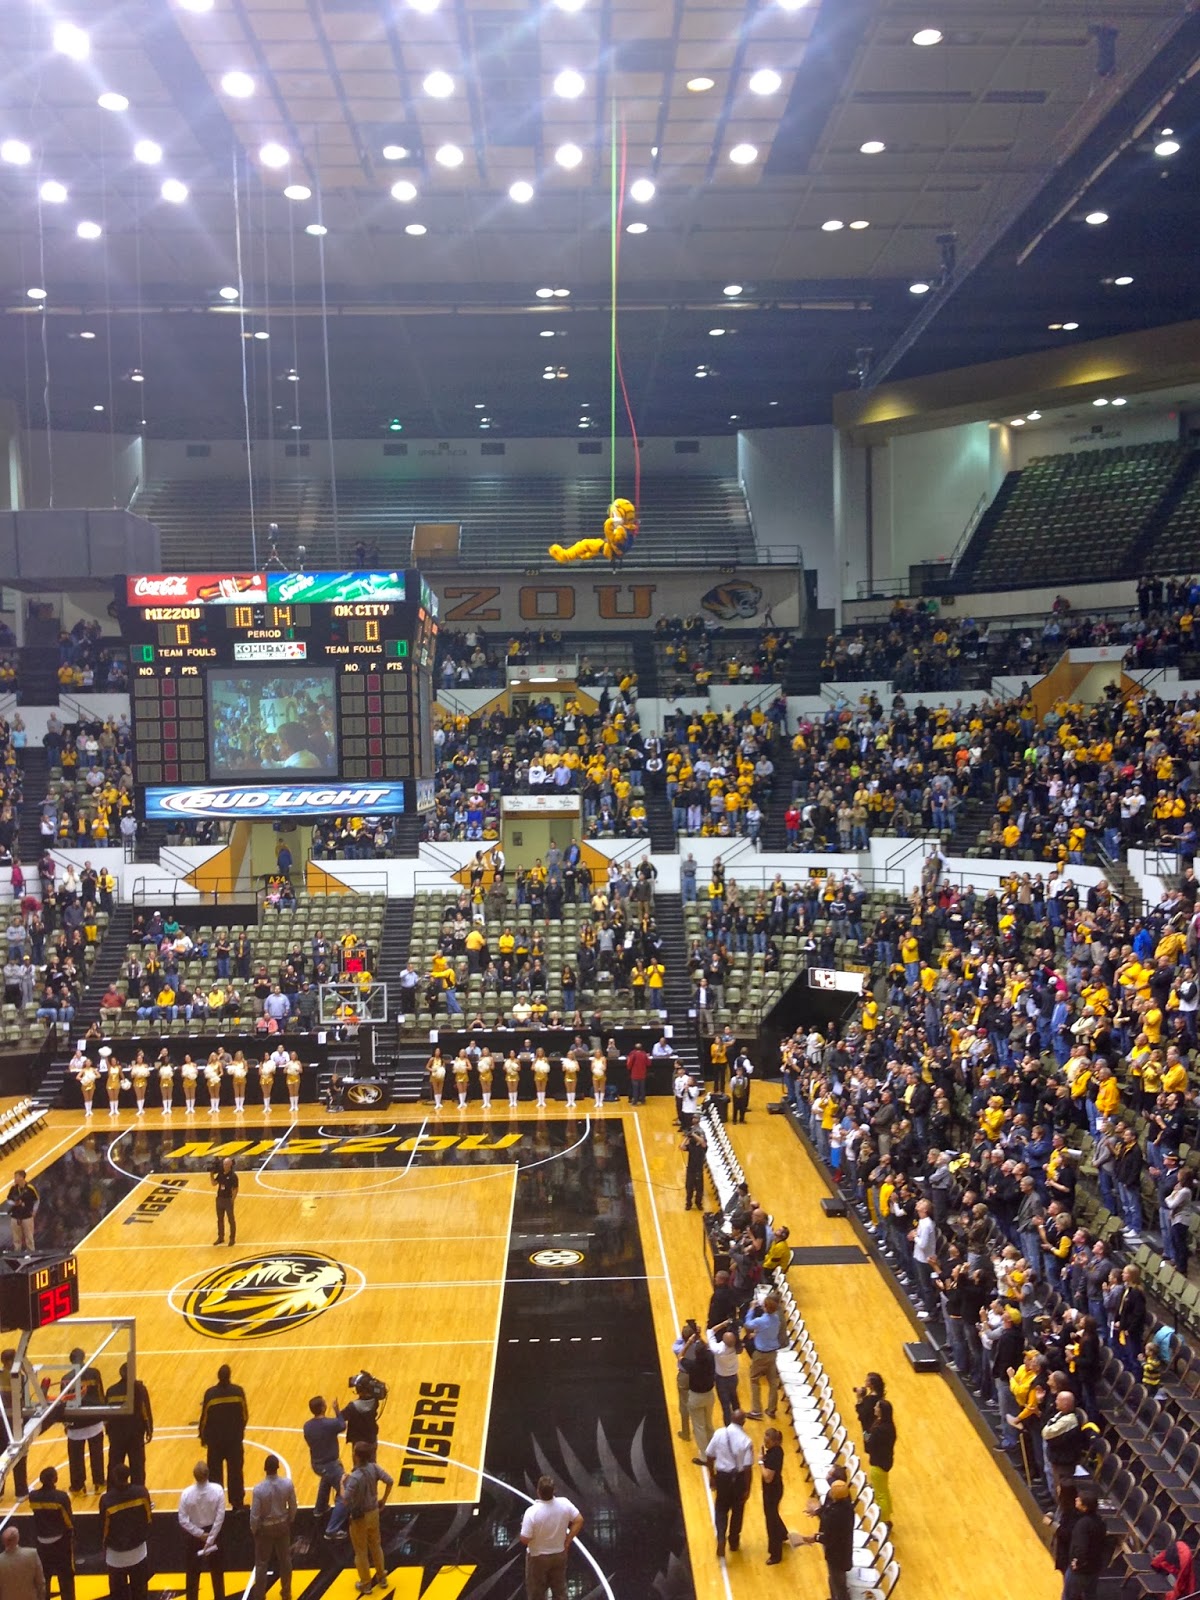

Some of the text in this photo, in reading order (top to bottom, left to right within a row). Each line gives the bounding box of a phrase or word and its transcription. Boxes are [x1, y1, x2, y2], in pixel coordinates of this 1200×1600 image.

[145, 607, 201, 620] MIZZOU
[334, 604, 390, 617] OK CITY
[176, 623, 190, 644] 0
[247, 630, 282, 639] PERIOD
[365, 620, 379, 641] 0
[143, 645, 153, 662] 0
[158, 647, 217, 658] TEAM FOULS
[325, 644, 383, 654] TEAM FOULS
[397, 641, 407, 656] 0
[165, 667, 172, 676] F
[370, 663, 377, 671] F
[184, 789, 390, 810] BUD LIGHT
[269, 875, 287, 884] A24
[811, 869, 827, 877] A22
[165, 1133, 524, 1158] MIZZOU
[122, 1178, 190, 1226] TIGERS
[35, 1258, 77, 1290] 10 14
[39, 1283, 72, 1327] 35
[397, 1381, 461, 1488] TIGERS
